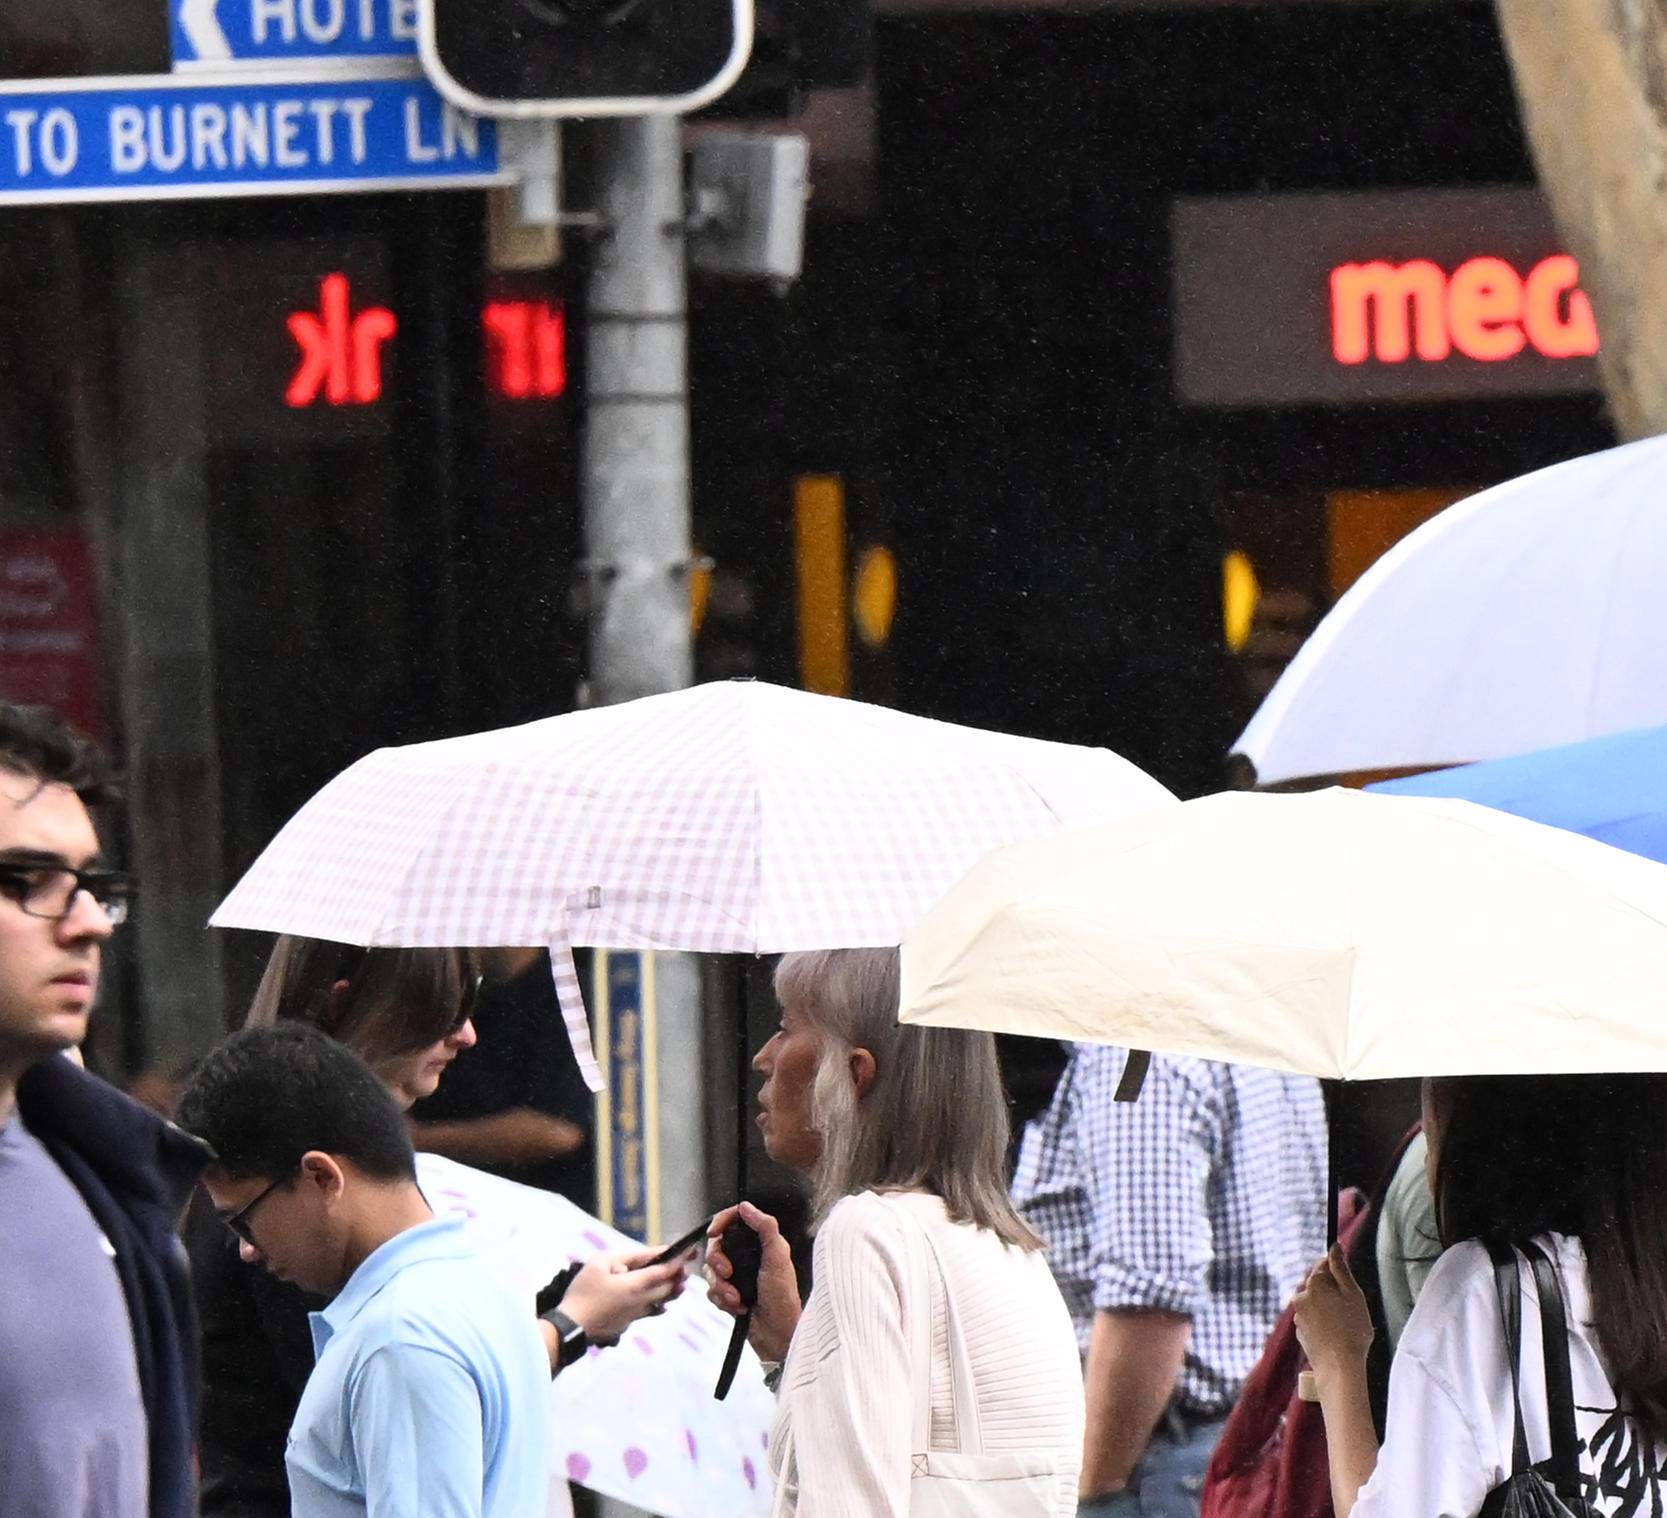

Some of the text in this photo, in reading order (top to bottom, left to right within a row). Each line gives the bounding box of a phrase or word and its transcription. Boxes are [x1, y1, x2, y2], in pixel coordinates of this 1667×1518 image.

[252, 0, 419, 43] HOTE
[8, 99, 480, 177] TO BURNETT LN
